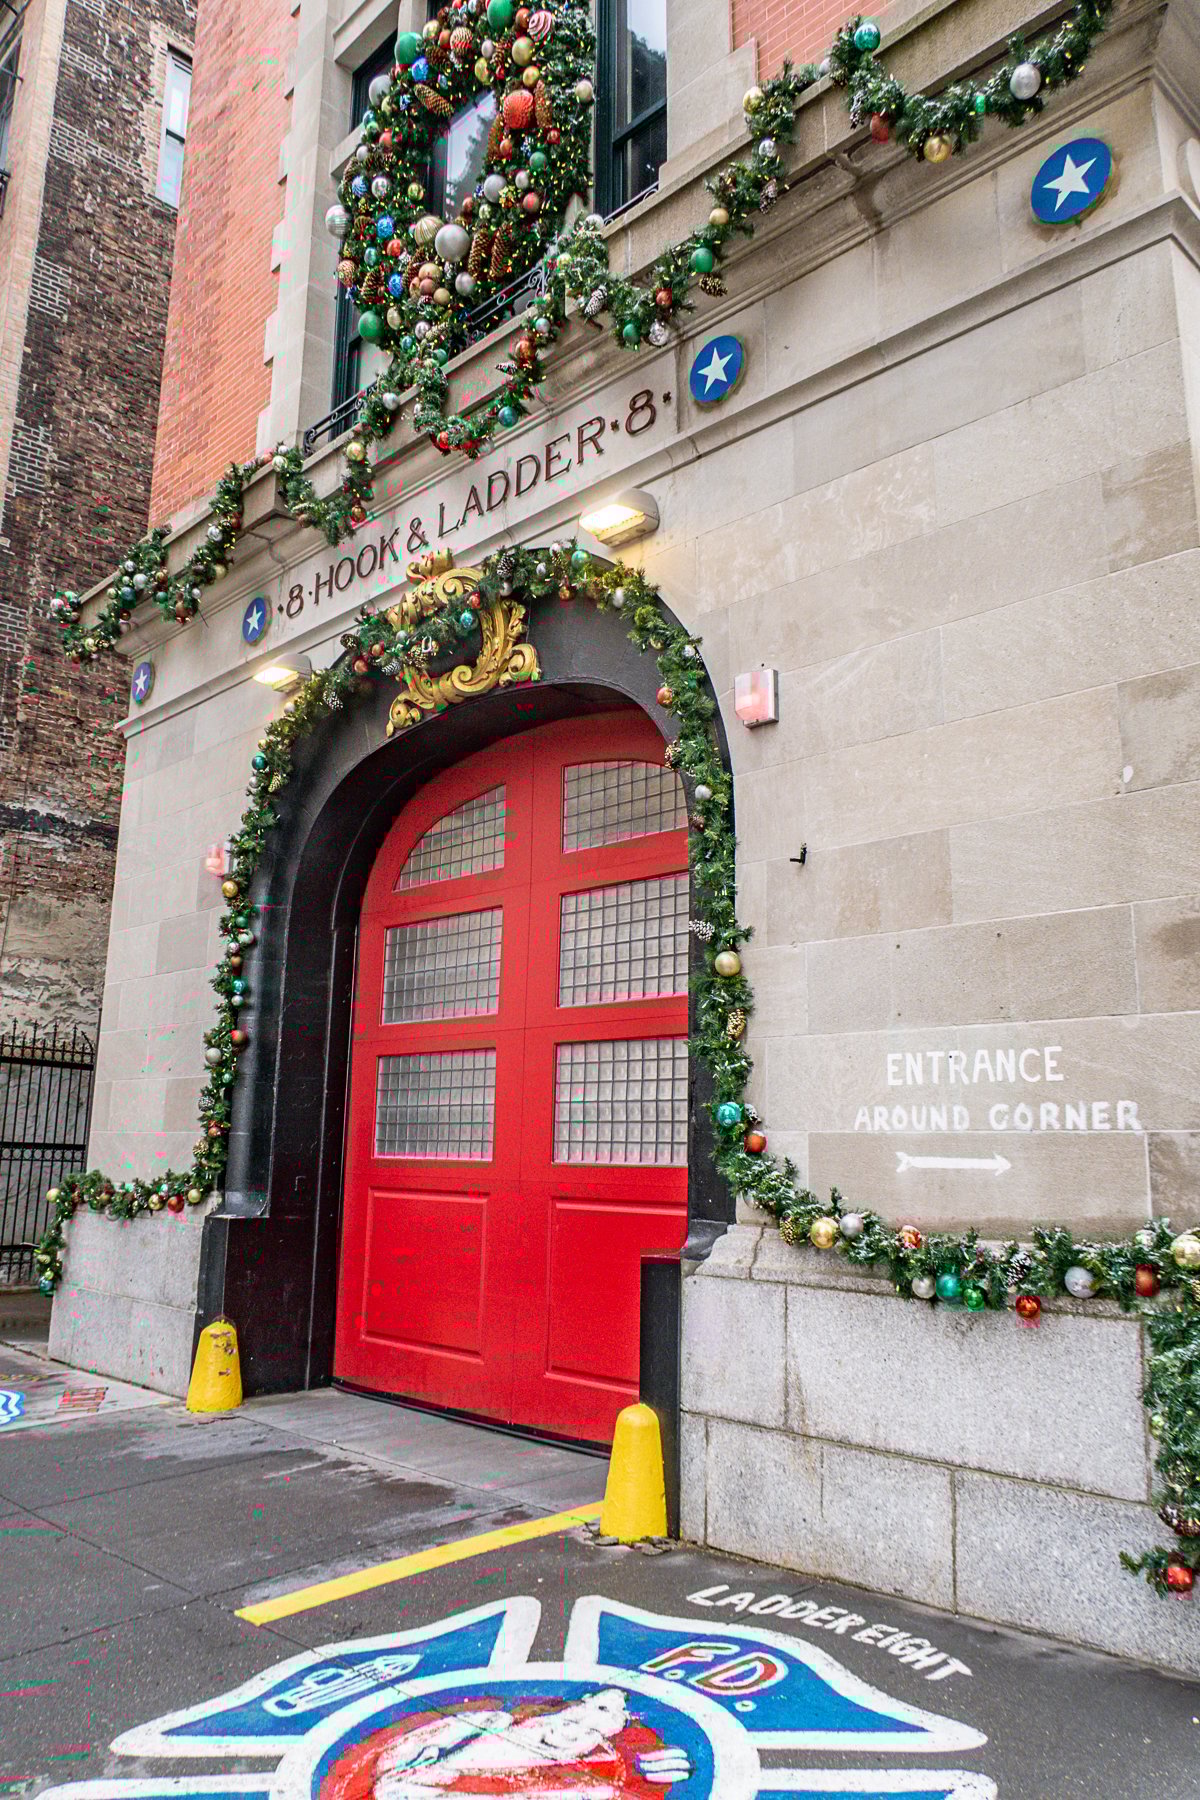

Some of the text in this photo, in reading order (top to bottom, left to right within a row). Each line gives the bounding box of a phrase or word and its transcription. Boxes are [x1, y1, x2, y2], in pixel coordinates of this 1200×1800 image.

[314, 526, 400, 605] HOOK
[406, 516, 429, 553] &
[437, 415, 605, 537] LADDER
[887, 1046, 1064, 1085] ENTRANCE
[854, 1100, 1142, 1131] AROUND CORNER
[686, 1584, 974, 1681] LADDER EIGHT
